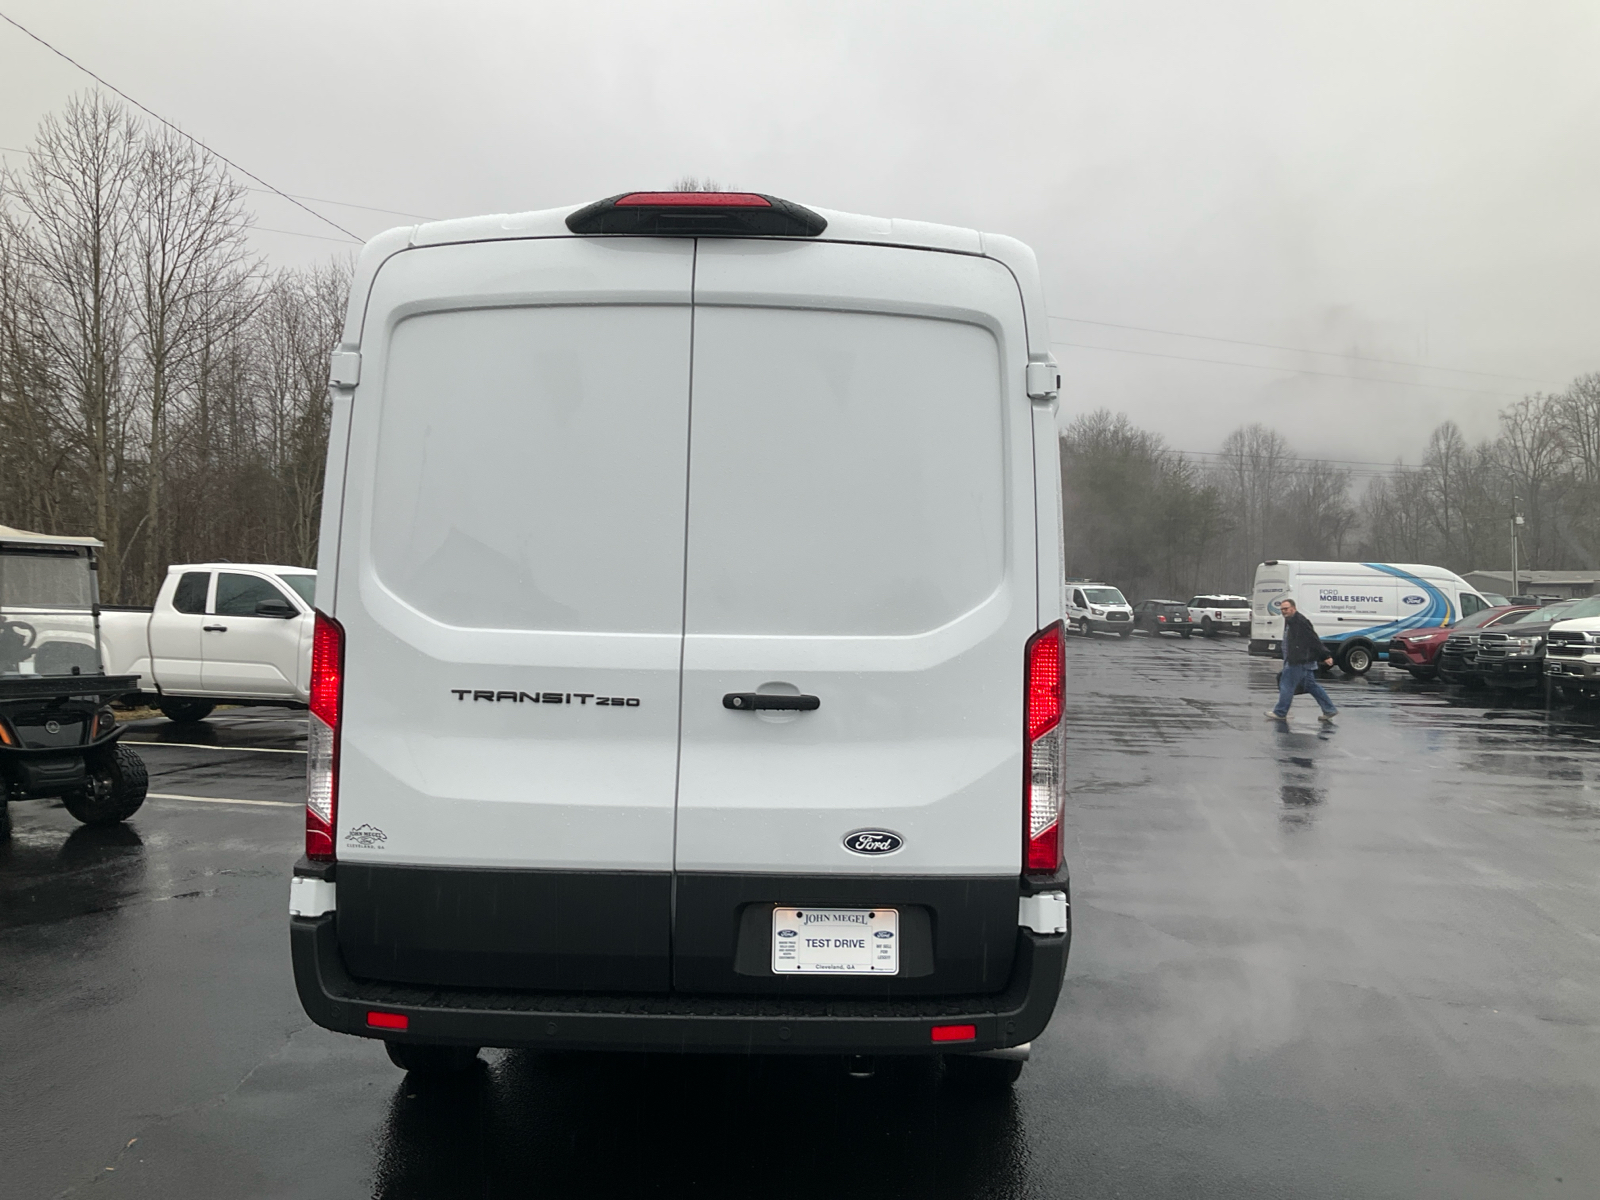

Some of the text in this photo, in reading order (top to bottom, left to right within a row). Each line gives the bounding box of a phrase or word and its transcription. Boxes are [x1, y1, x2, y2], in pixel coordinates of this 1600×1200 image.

[451, 689, 640, 707] TRANSIT 250
[855, 834, 892, 850] Ford
[804, 914, 868, 925] JOHN MEGEL
[805, 939, 865, 948] TEST DRIVE
